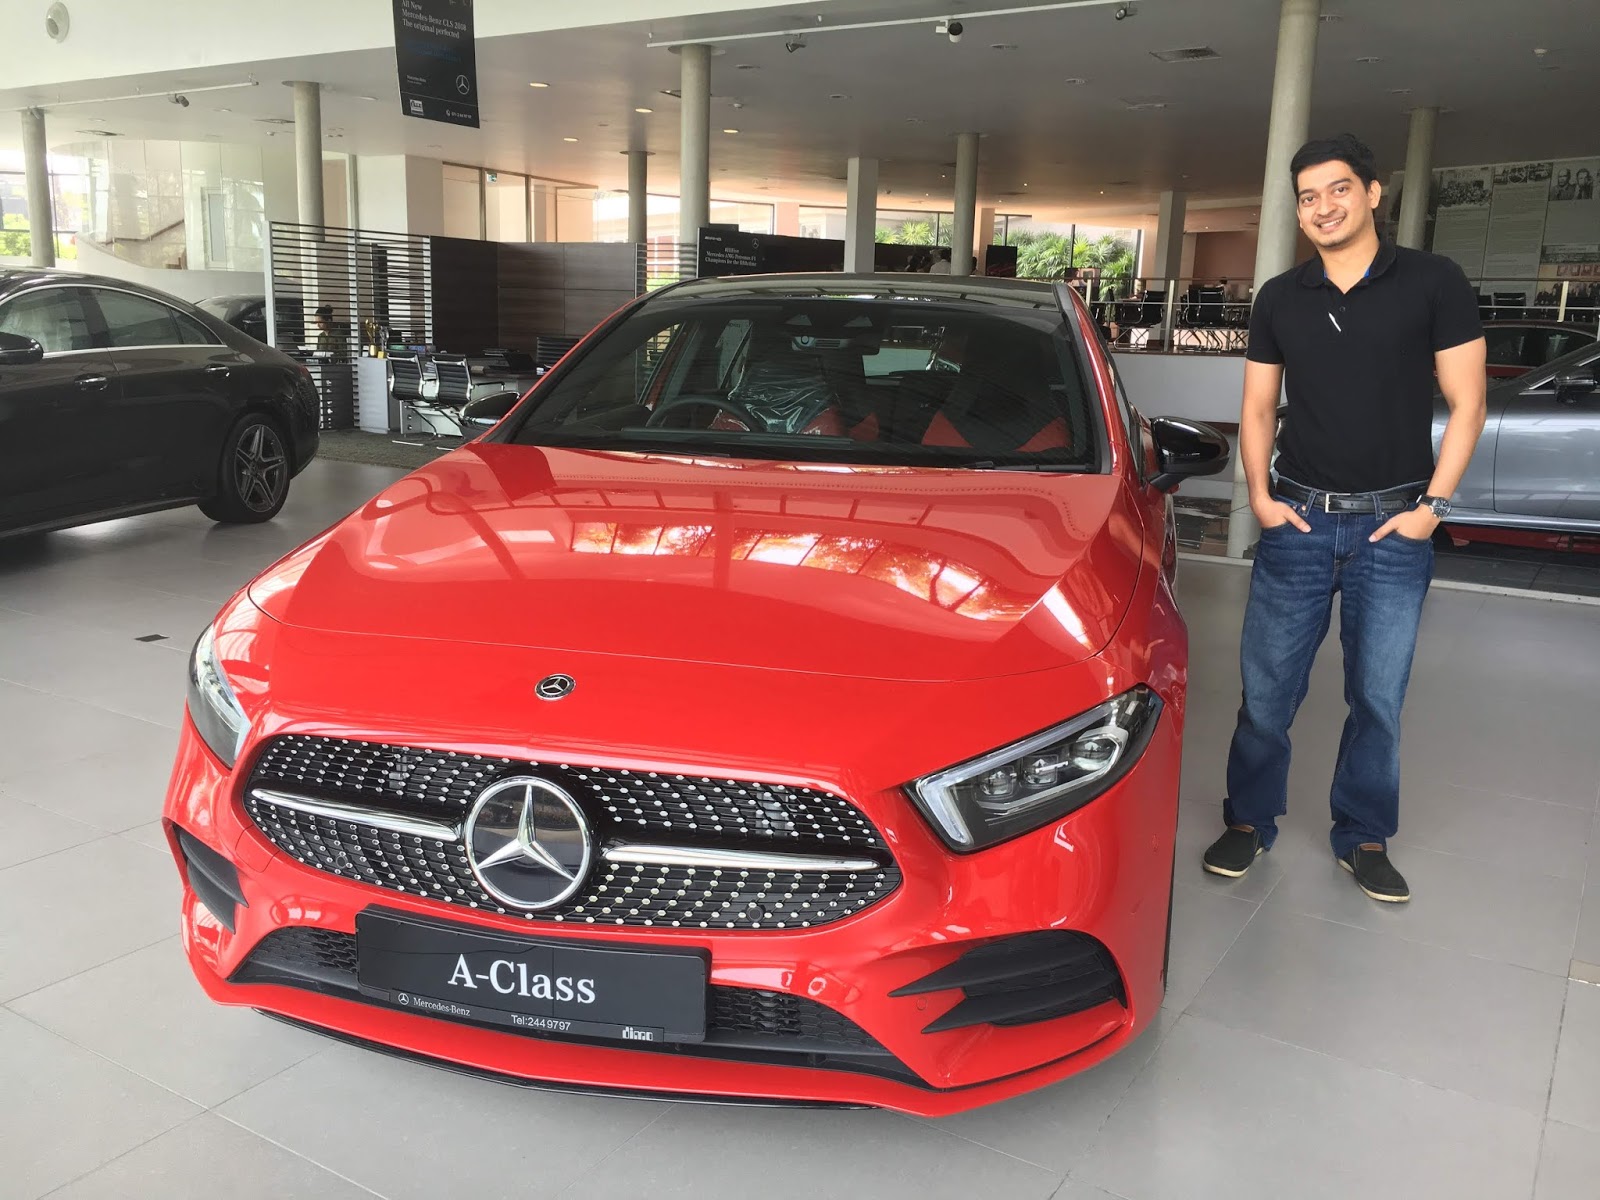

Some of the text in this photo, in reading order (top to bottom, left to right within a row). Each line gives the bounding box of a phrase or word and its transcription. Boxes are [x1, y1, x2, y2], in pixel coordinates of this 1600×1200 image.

[410, 1, 423, 10] New
[402, 18, 460, 39] The original perfected
[442, 18, 454, 28] CLS
[448, 953, 596, 1004] A-Class
[413, 997, 471, 1017] Mercedes-Benz
